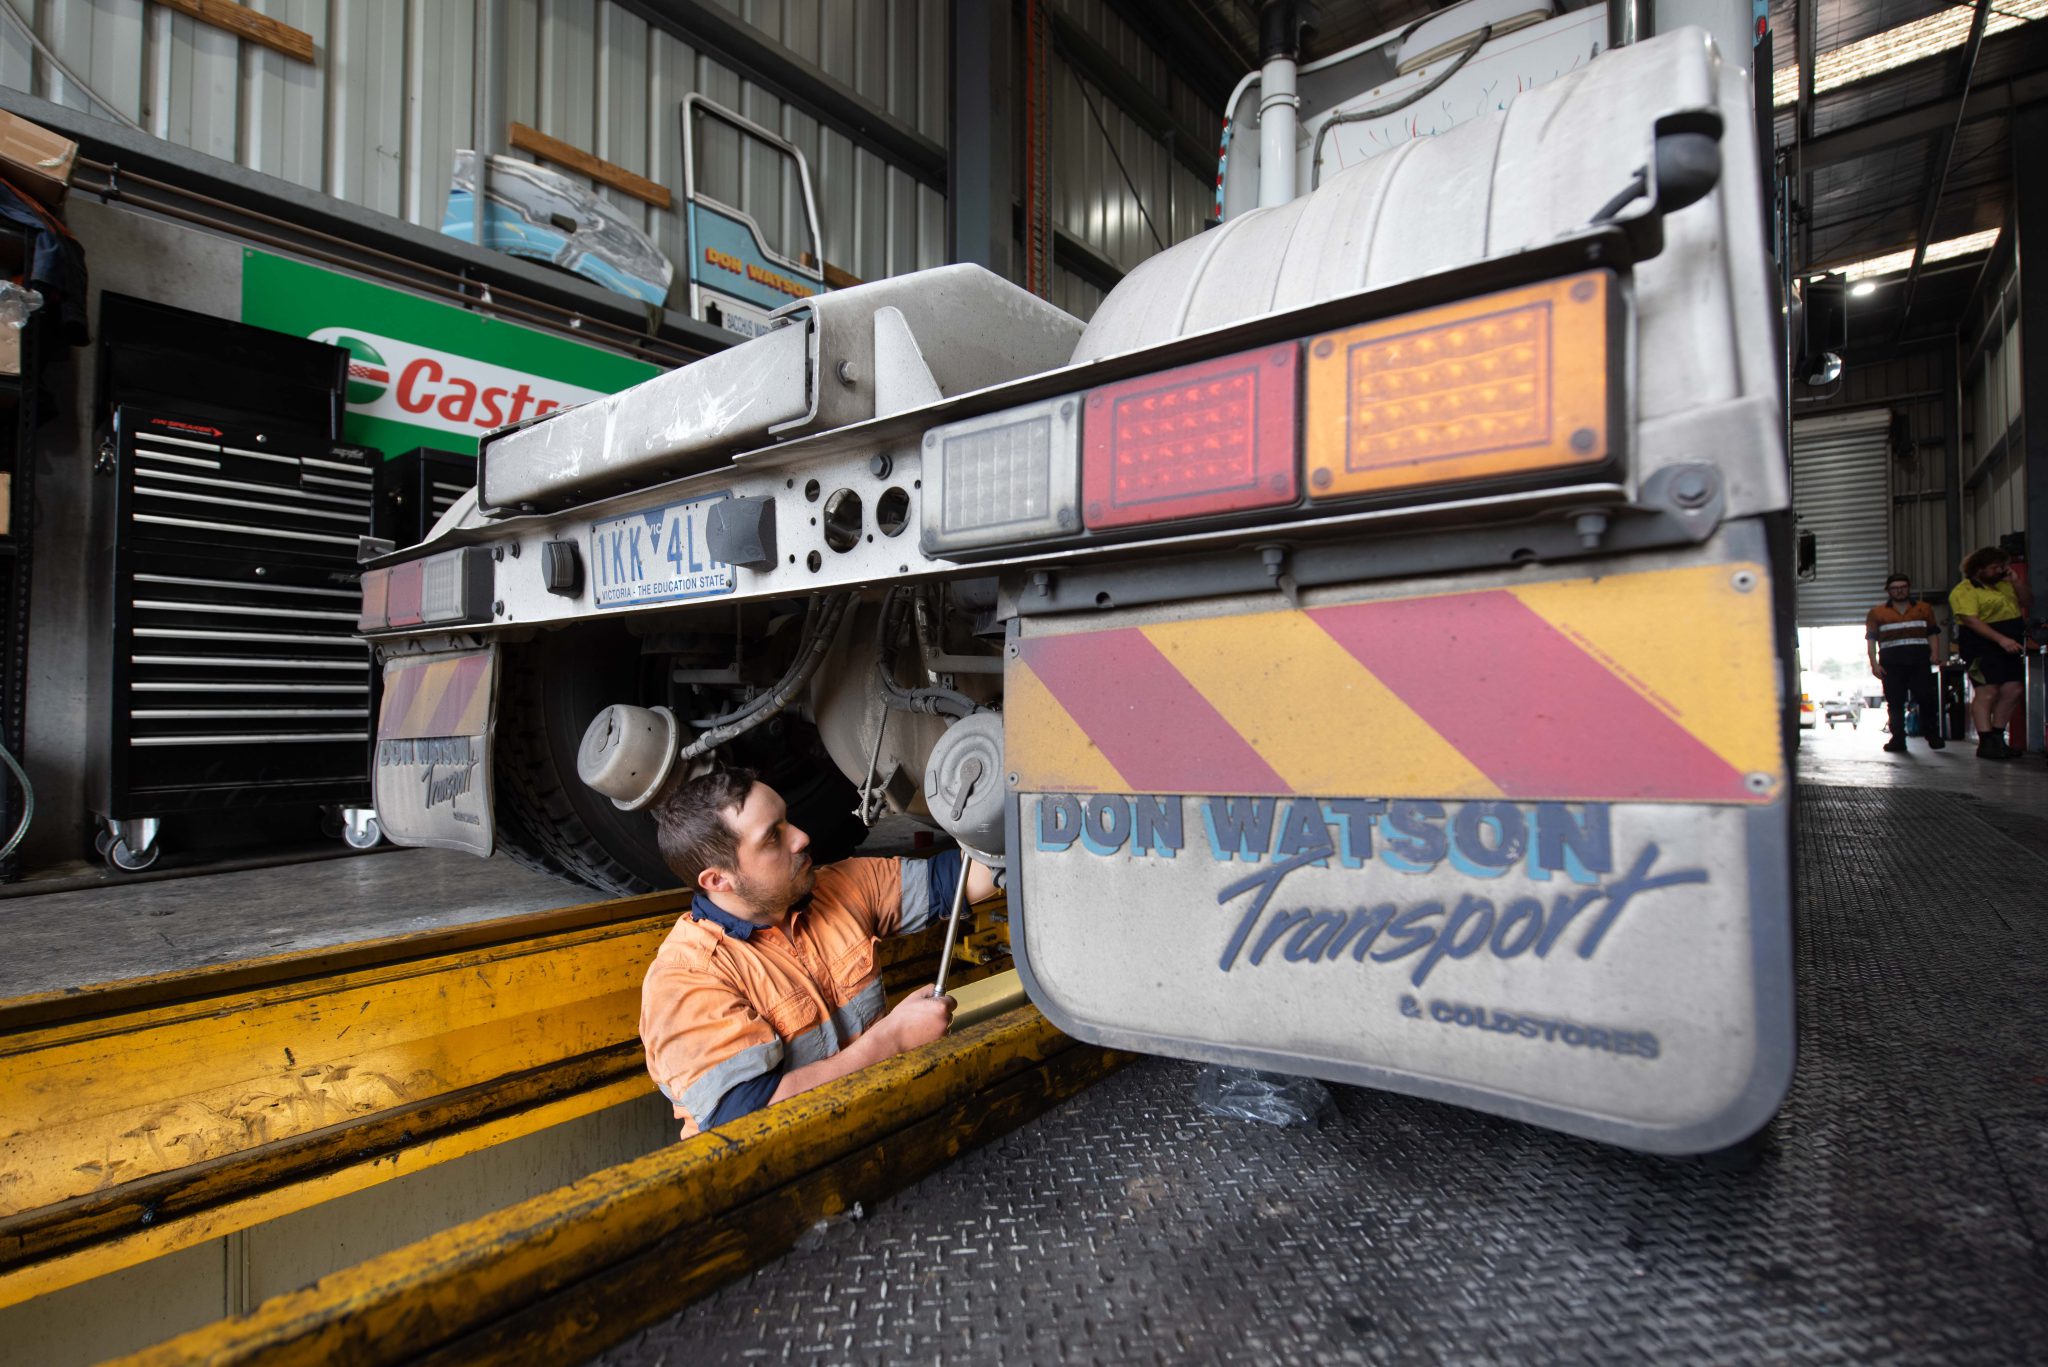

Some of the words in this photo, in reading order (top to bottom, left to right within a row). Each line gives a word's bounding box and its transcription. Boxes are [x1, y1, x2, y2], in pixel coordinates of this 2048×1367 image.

[705, 247, 742, 275] DON
[746, 263, 814, 299] WATSON
[396, 357, 576, 429] Castr
[598, 525, 645, 587] 1KK
[666, 514, 726, 575] 4L
[602, 586, 632, 601] VICTORIA
[638, 583, 652, 596] THE
[653, 578, 698, 594] EDUCATION
[699, 573, 725, 588] STATE
[380, 738, 415, 767] DON
[416, 736, 470, 766] WATSON
[421, 749, 480, 810] Transport
[1035, 793, 1185, 859] DON
[1200, 795, 1614, 885] WATSON
[1217, 838, 1710, 988] Transport
[1399, 994, 1422, 1019] &
[1429, 998, 1661, 1060] COLDSTORES
